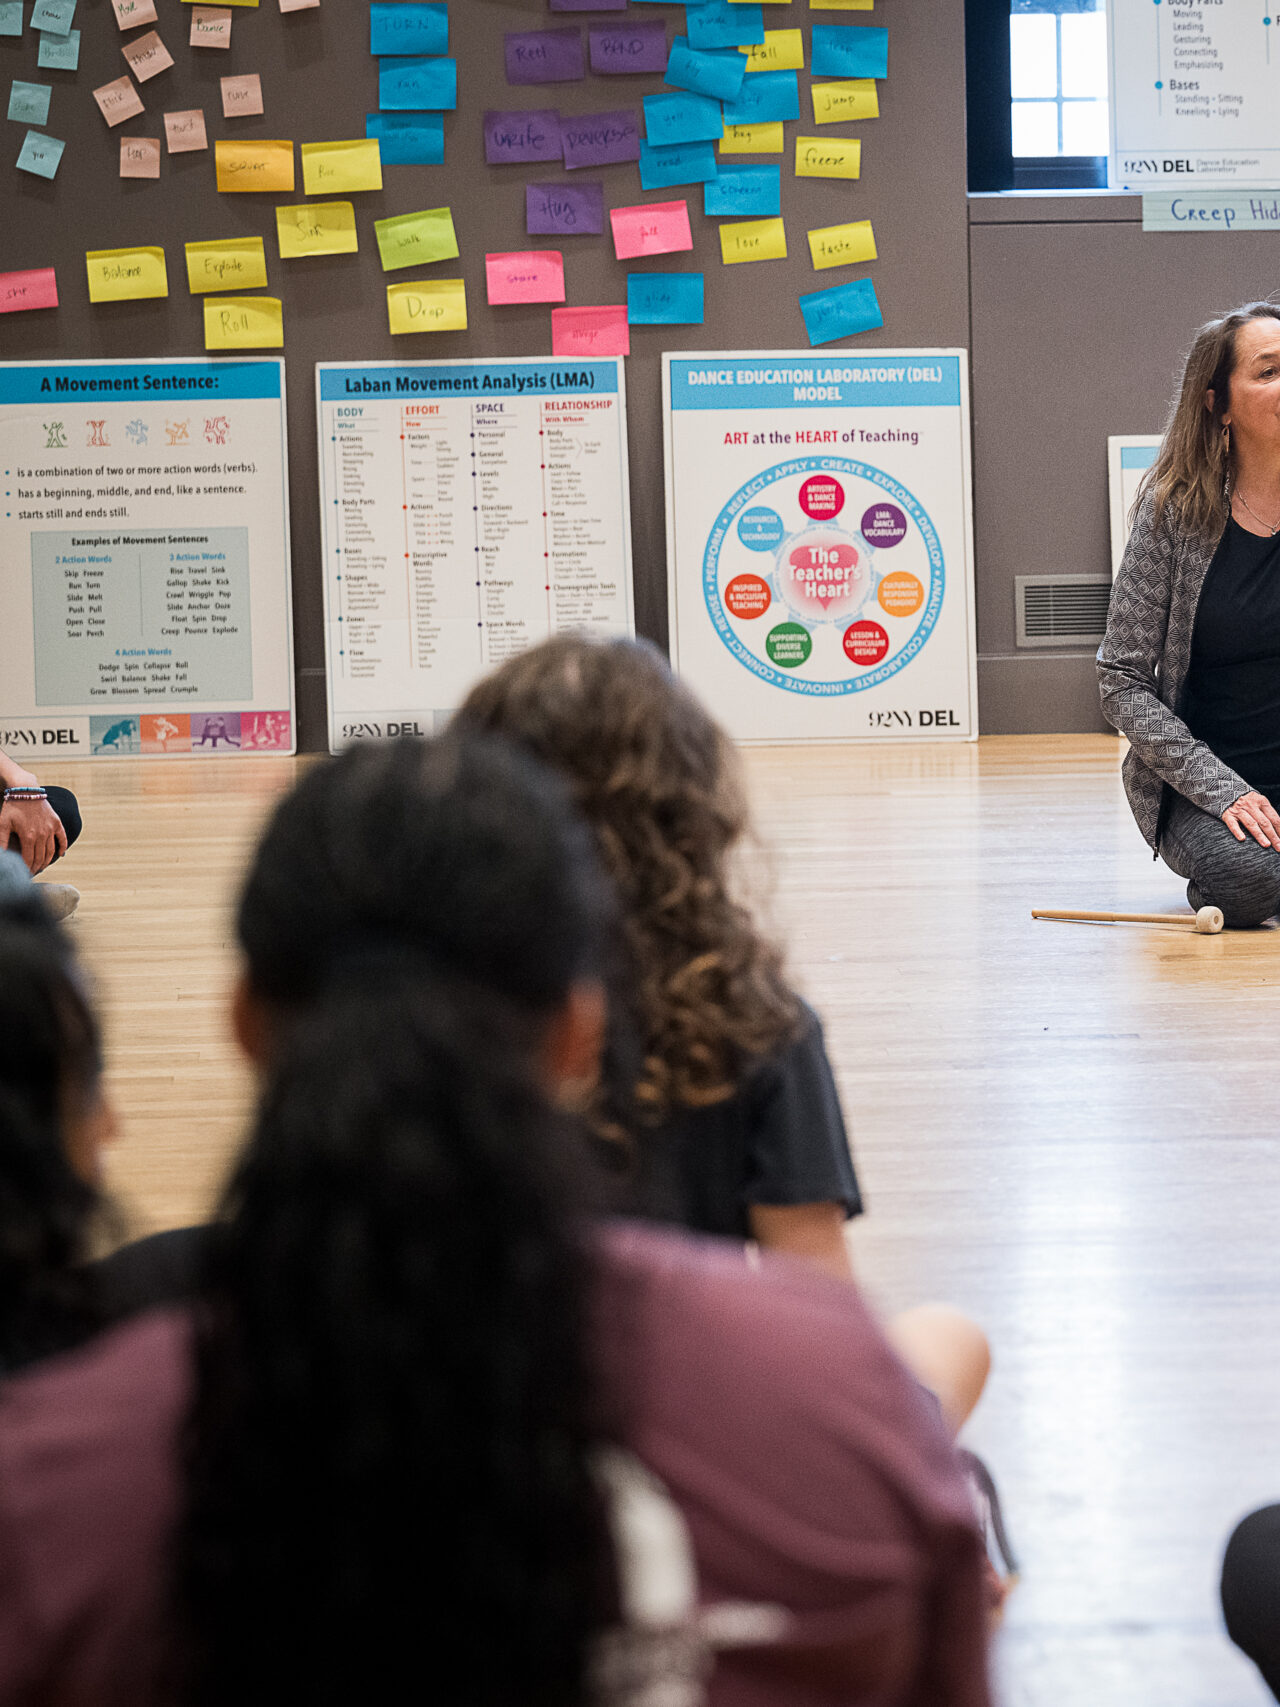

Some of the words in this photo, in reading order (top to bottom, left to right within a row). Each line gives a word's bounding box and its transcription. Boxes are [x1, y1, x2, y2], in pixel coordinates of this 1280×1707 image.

[1173, 10, 1202, 20] Moving
[1173, 22, 1204, 33] Leading
[1173, 34, 1211, 45] Gesturing
[750, 43, 777, 61] fall
[1174, 48, 1218, 58] Connecting
[1174, 60, 1223, 71] Emphasizing
[1169, 79, 1200, 90] Bases
[824, 95, 856, 111] jump
[803, 148, 846, 167] freeze
[1163, 160, 1194, 173] DEL
[1171, 199, 1235, 228] Creep
[819, 241, 853, 257] taste
[407, 295, 444, 319] Drop
[220, 310, 249, 336] Roll
[41, 379, 51, 392] A
[55, 377, 139, 391] Movement
[143, 375, 219, 390] Sentence:
[345, 377, 391, 392] Laban
[396, 375, 478, 392] Movement
[482, 373, 546, 393] Analysis
[550, 371, 595, 390] (LMA)
[688, 370, 734, 385] DANCE
[736, 368, 813, 384] EDUCATION
[816, 367, 905, 383] LABORATORY
[907, 366, 942, 383] (DEL)
[793, 386, 842, 401] MODEL
[337, 407, 363, 417] BODY
[405, 405, 440, 415] EFFORT
[476, 403, 504, 413] SPACE
[545, 400, 612, 411] RELATIONSHIP
[724, 432, 749, 445] ART
[752, 432, 765, 444] at
[769, 430, 791, 443] the
[795, 430, 838, 443] HEART
[842, 429, 855, 443] of
[859, 428, 919, 446] Teaching
[18, 467, 25, 477] is
[35, 465, 93, 477] combination
[95, 466, 104, 475] of
[107, 466, 124, 475] two
[138, 467, 162, 475] more
[164, 463, 192, 474] action
[194, 463, 221, 474] words
[223, 462, 258, 475] (verbs).
[774, 460, 808, 479] APPLY
[821, 458, 865, 475] CREATE
[18, 489, 34, 498] has
[44, 487, 95, 500] beginning,
[97, 486, 132, 498] middle,
[135, 486, 151, 496] and
[154, 485, 174, 496] end,
[177, 484, 193, 495] like
[195, 487, 201, 495] a
[203, 484, 246, 495] sentence.
[727, 478, 765, 515] REFLECT
[873, 473, 917, 511] EXPLORE
[18, 509, 44, 519] starts
[46, 508, 63, 519] still
[65, 508, 82, 519] and
[85, 507, 107, 518] ends
[109, 506, 130, 518] still.
[71, 537, 111, 547] Examples
[112, 536, 121, 545] of
[122, 535, 166, 545] Movement
[168, 534, 208, 544] Sentences
[918, 516, 941, 567] DEVELOP
[706, 527, 725, 582] PERFORM
[808, 547, 839, 564] The
[789, 564, 861, 581] Teacher's
[805, 581, 850, 598] Heart
[924, 579, 943, 629] ANALYZE
[708, 594, 728, 632] REVISE
[729, 640, 775, 680] CONNECT
[855, 636, 923, 686] COLLABORATE
[784, 678, 844, 695] INNOVATE
[919, 710, 960, 727] DEL
[42, 729, 80, 745] DEL
[387, 722, 425, 737] DEL
